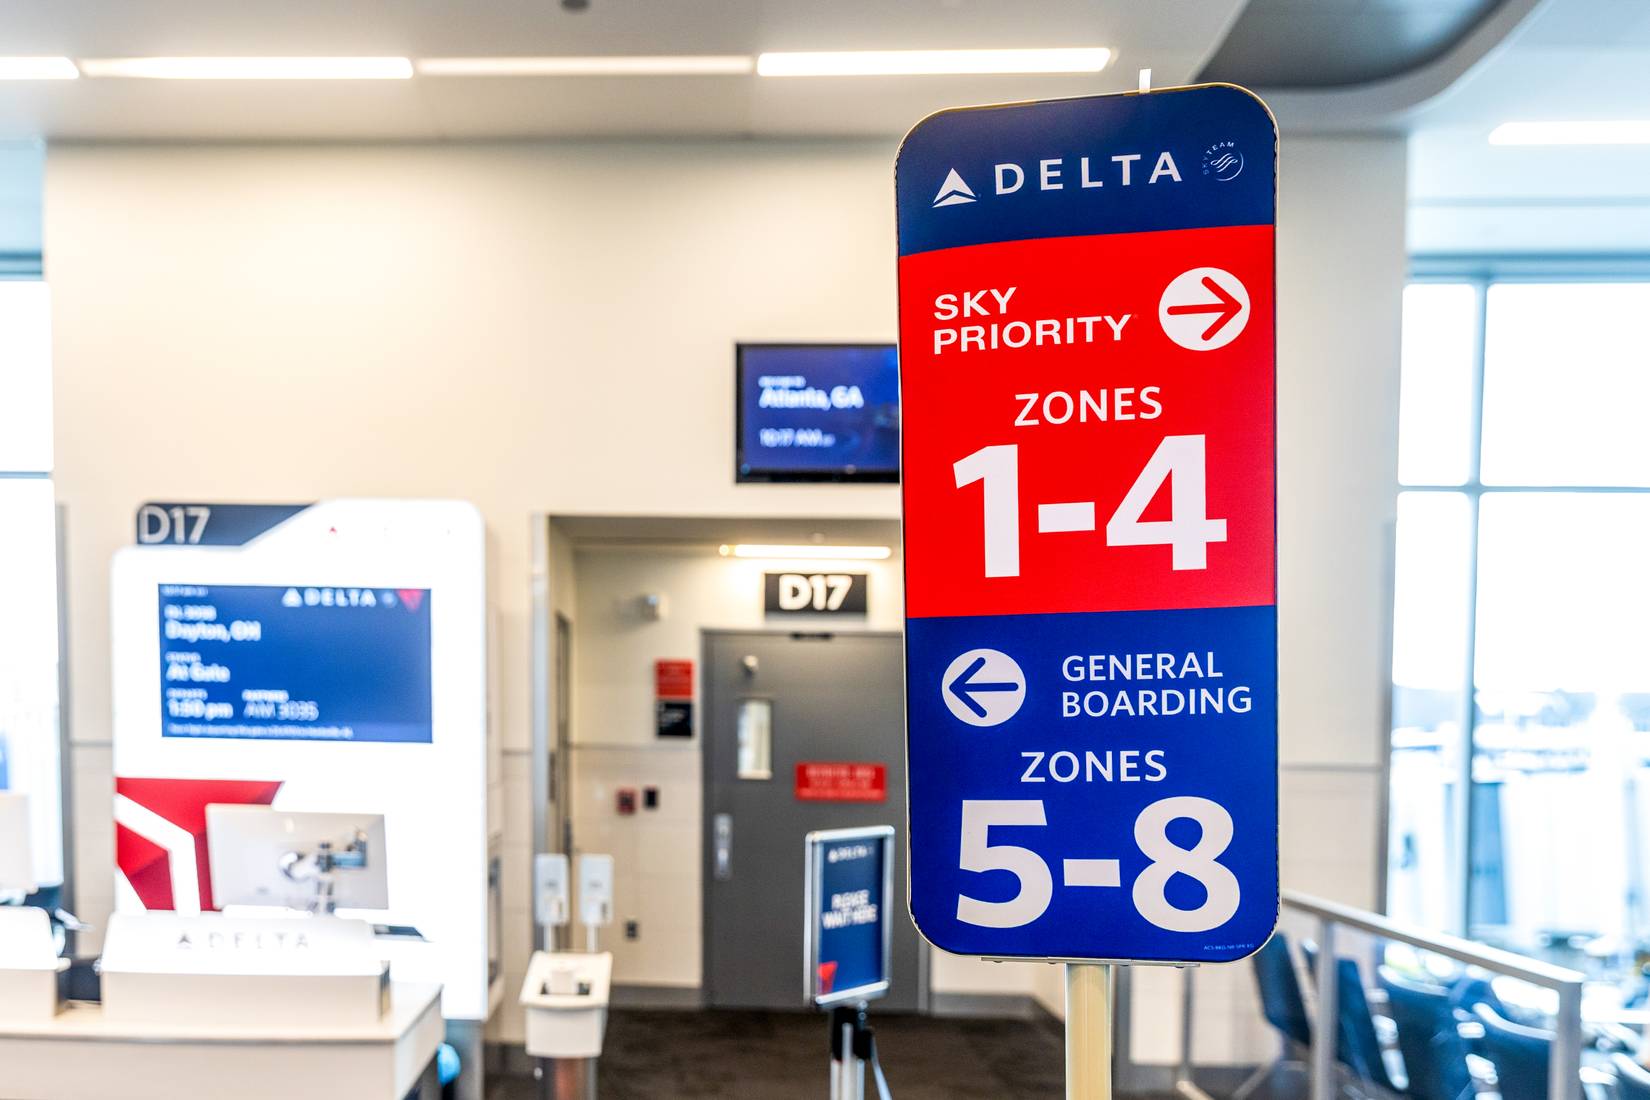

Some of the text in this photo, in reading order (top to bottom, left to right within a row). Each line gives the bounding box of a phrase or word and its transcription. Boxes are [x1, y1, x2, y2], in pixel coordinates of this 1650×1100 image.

[994, 151, 1182, 195] DELTA
[934, 286, 1018, 321] SKY
[933, 314, 1133, 355] PRIORITY
[830, 385, 865, 409] GA
[1014, 386, 1163, 427] ZONES
[952, 434, 1228, 578] 1-4
[138, 505, 211, 545] D17
[304, 588, 377, 608] DELTA
[779, 573, 853, 611] D17
[231, 619, 262, 642] OH
[1062, 651, 1224, 682] GENERAL
[1062, 686, 1253, 718] BOARDING
[1020, 749, 1167, 783] ZONES
[956, 796, 1241, 933] 5-8
